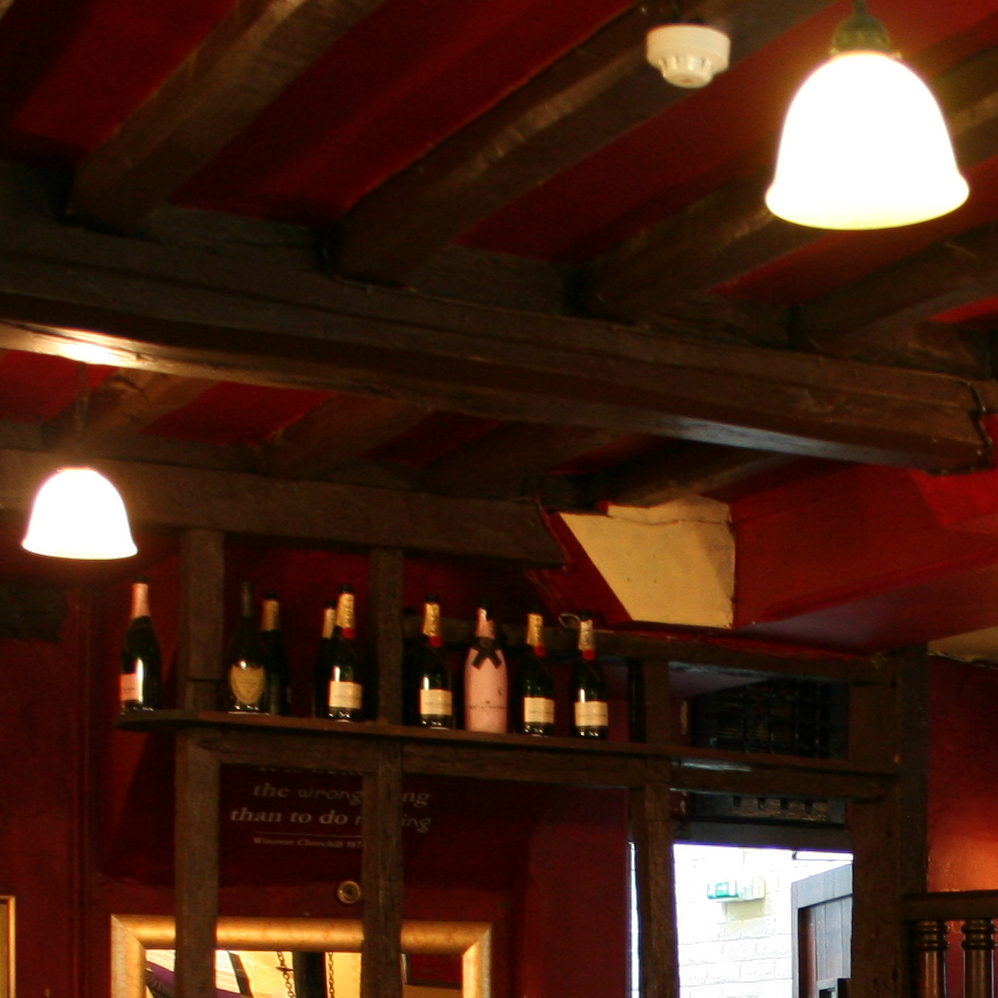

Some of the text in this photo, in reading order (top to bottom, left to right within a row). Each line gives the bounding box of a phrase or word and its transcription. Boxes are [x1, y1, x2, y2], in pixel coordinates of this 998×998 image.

[253, 781, 363, 807] the wrong
[229, 806, 282, 823] than
[289, 810, 312, 824] to
[318, 809, 348, 825] do
